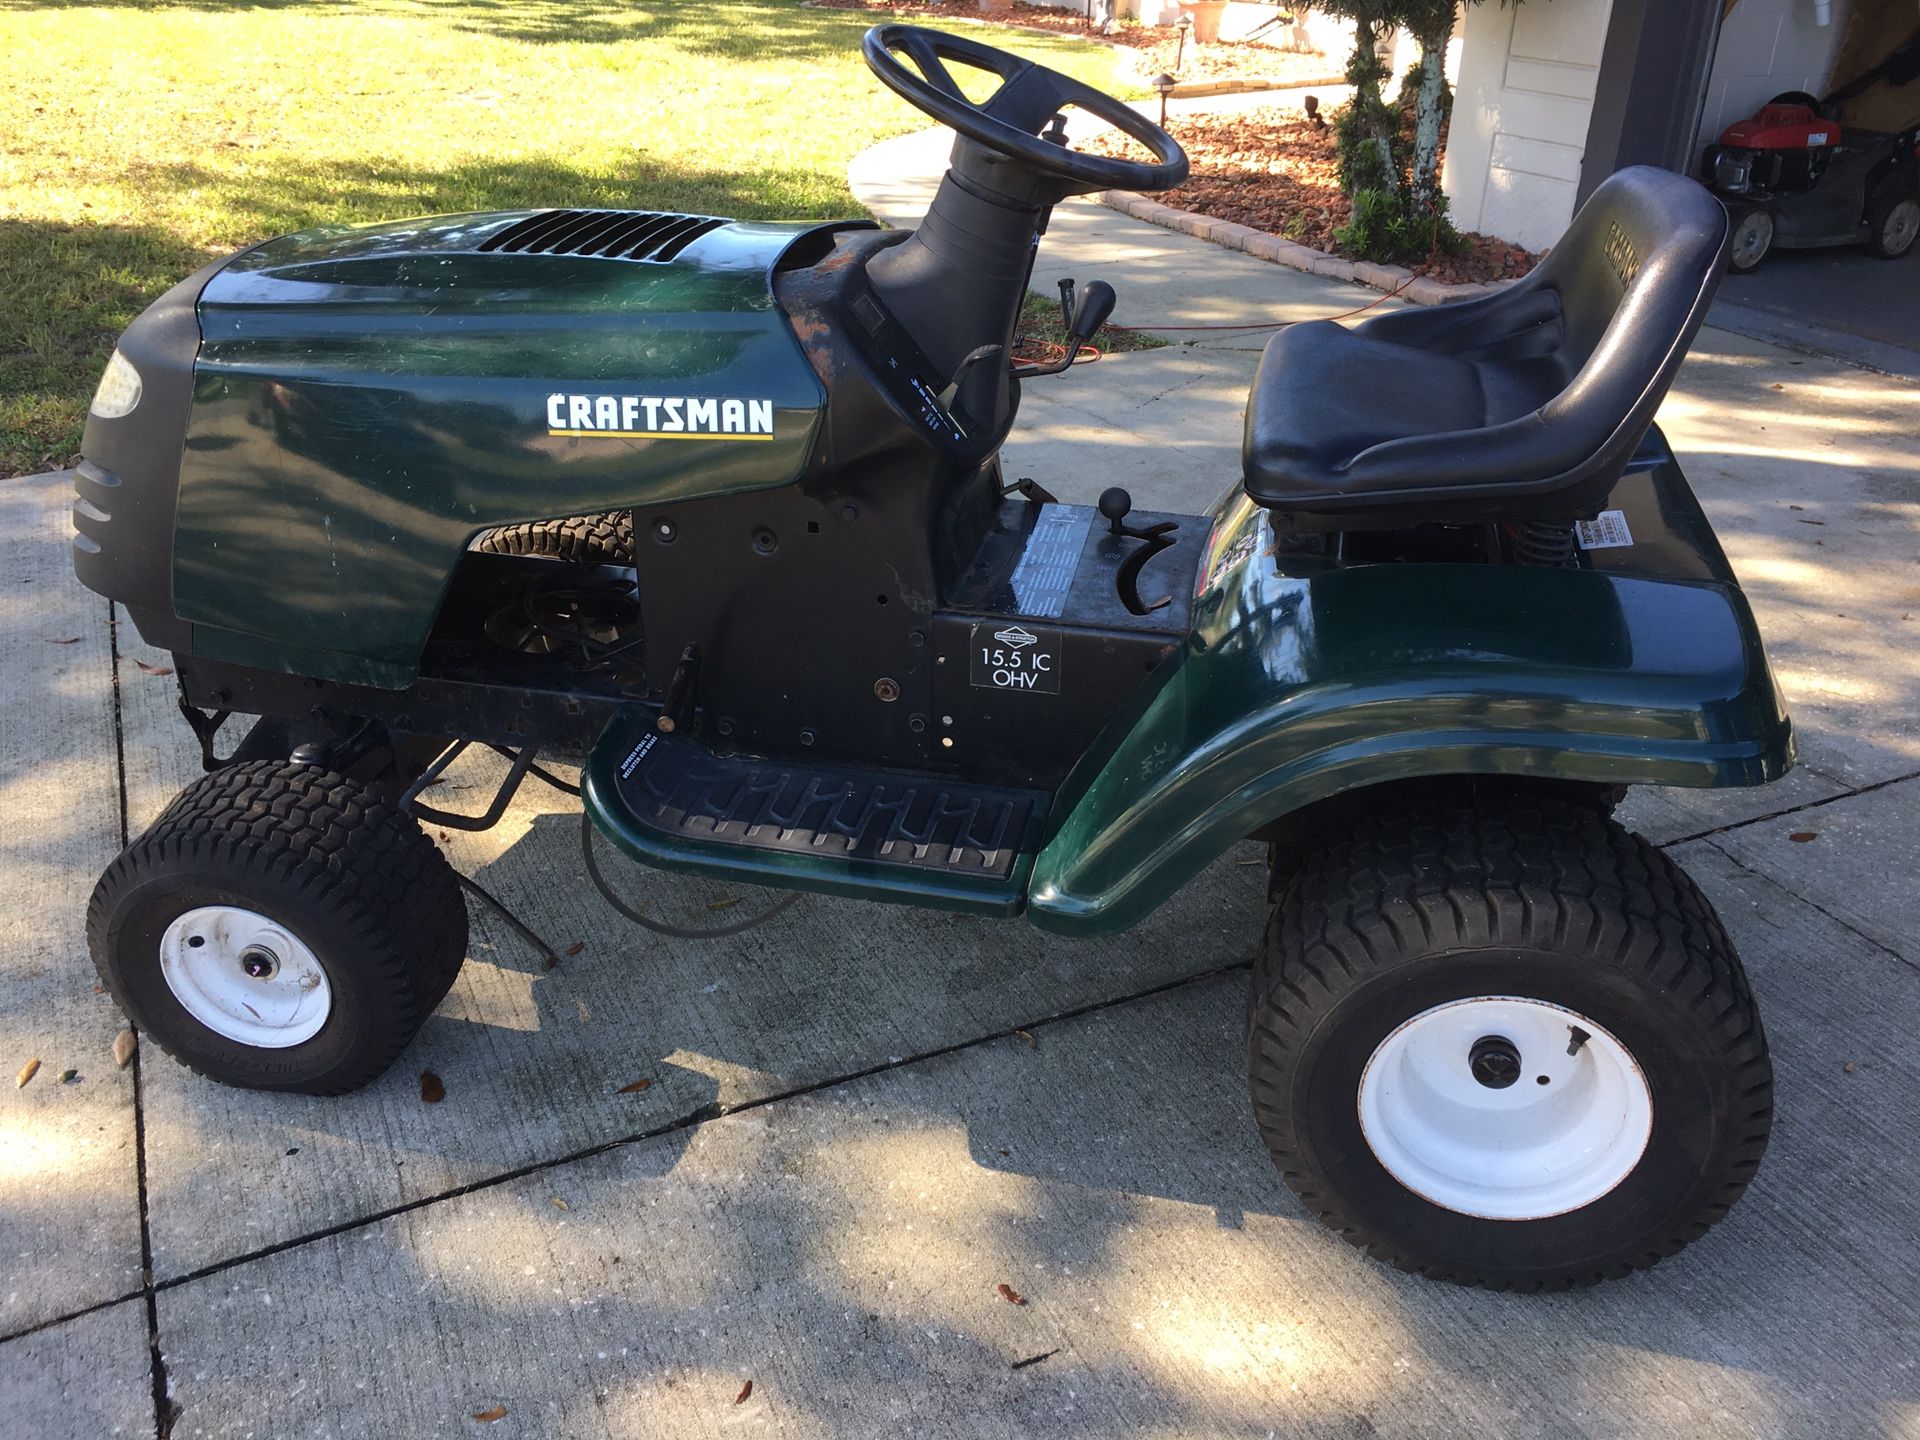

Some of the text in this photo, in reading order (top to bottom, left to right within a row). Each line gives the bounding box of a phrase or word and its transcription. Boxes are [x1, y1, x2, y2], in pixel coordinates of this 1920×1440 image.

[547, 393, 774, 433] CRAFTSMAN
[982, 648, 1051, 671] 15.5 IC
[993, 669, 1039, 689] OHV
